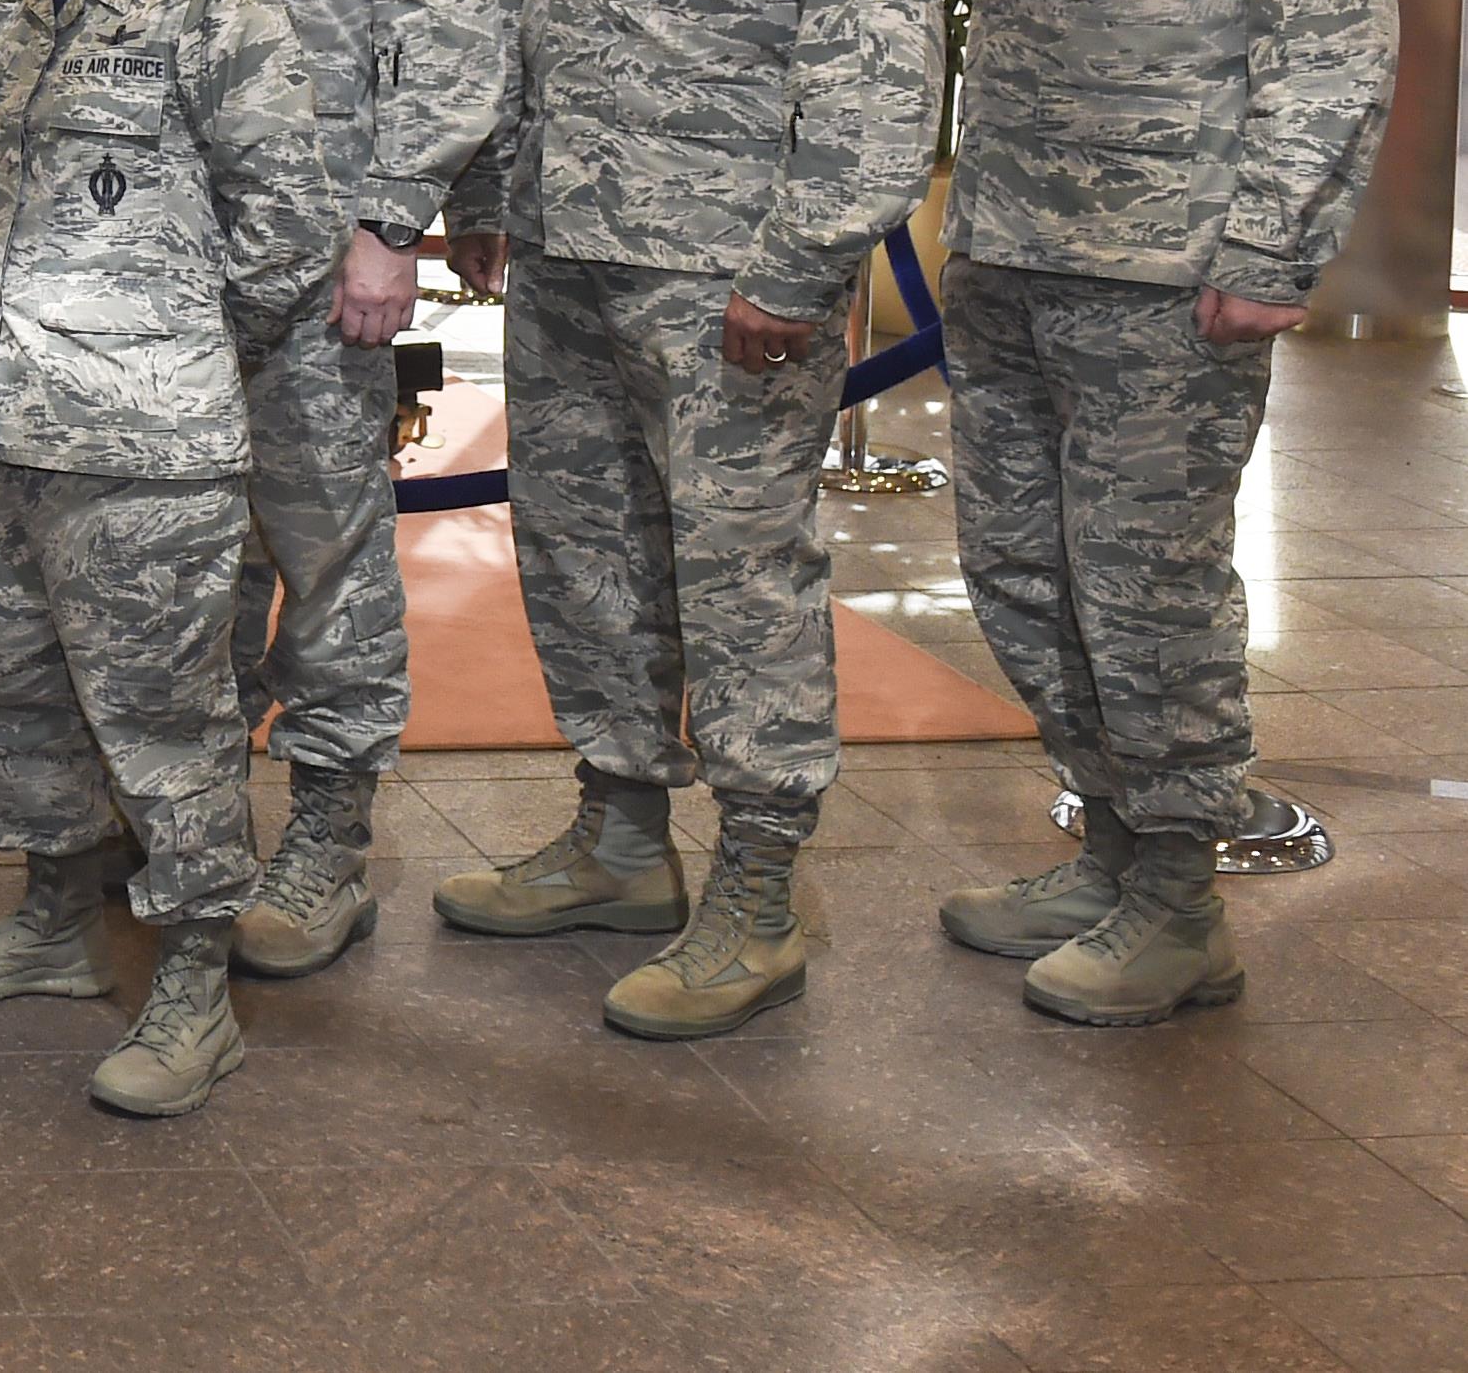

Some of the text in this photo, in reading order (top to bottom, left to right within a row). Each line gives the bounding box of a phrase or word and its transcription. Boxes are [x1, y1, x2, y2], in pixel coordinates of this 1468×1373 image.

[63, 58, 165, 79] US AIR FORCE
